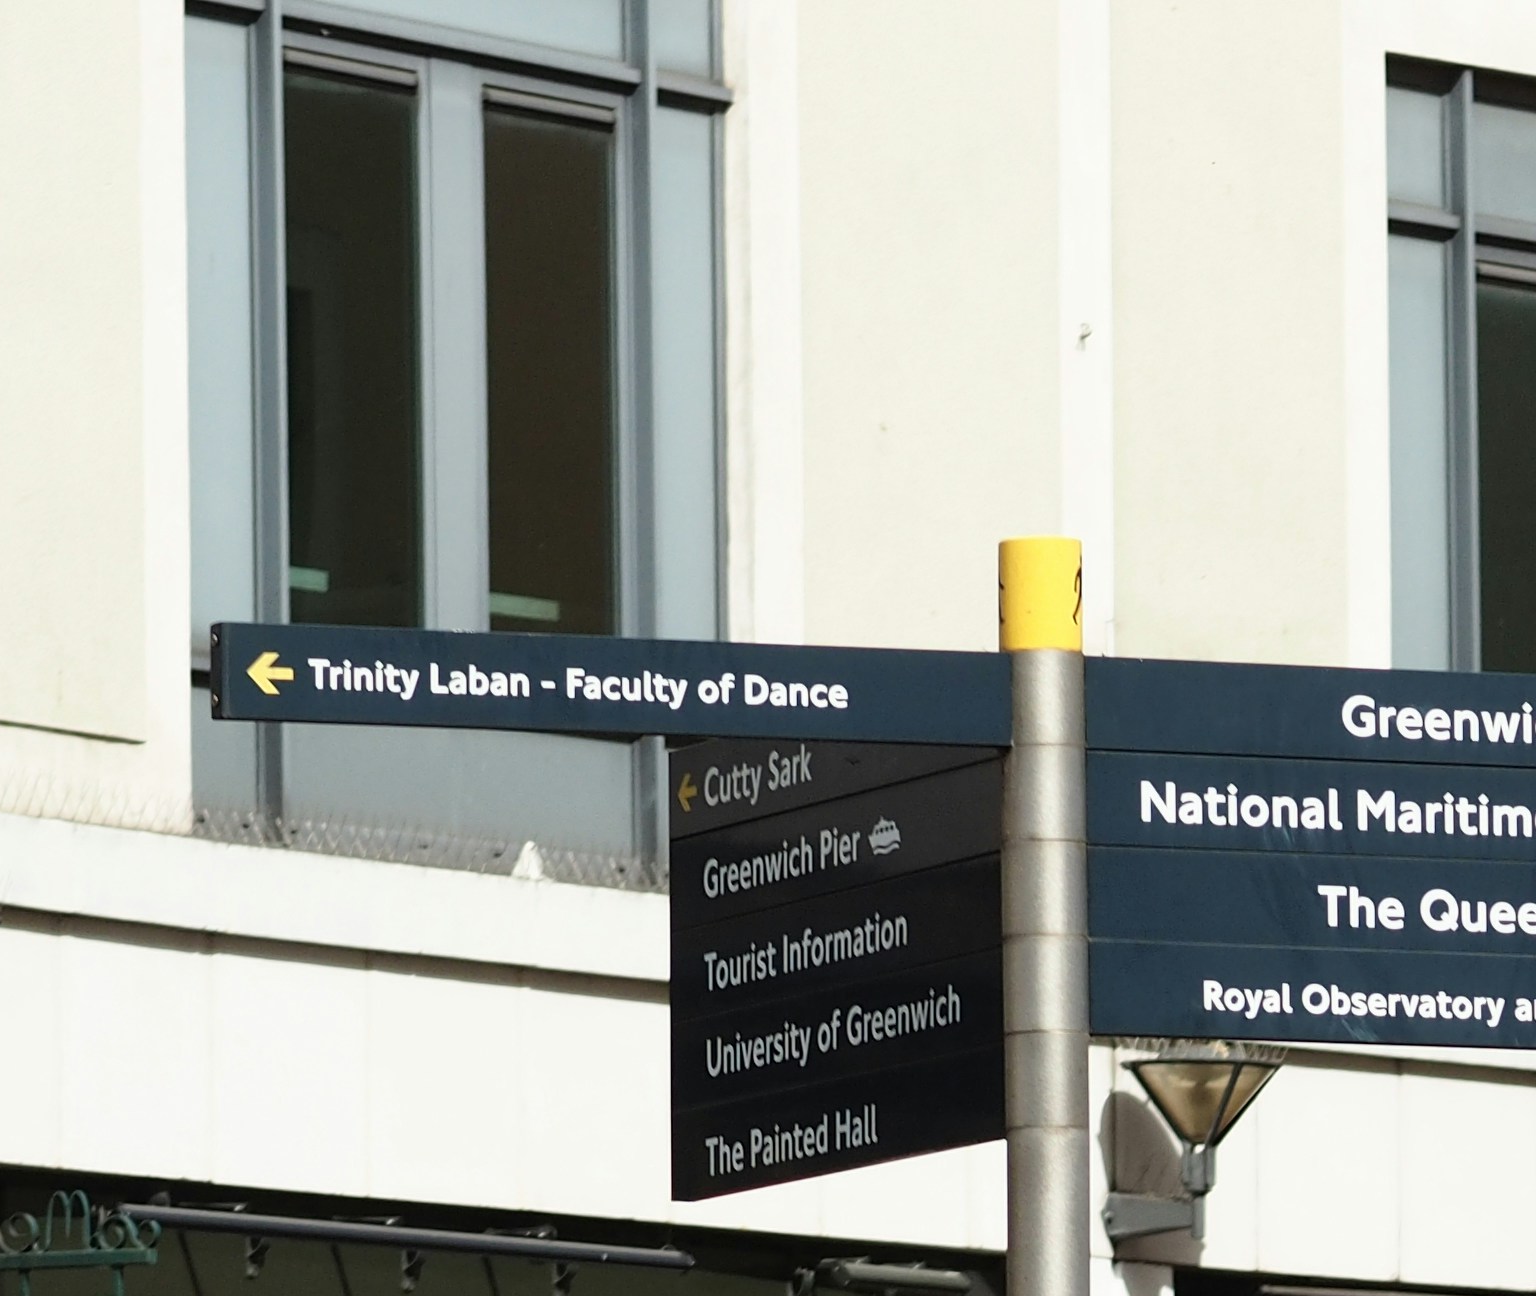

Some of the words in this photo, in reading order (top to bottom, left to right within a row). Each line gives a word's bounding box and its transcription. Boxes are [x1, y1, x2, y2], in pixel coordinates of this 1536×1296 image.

[307, 657, 420, 701] Trinity
[429, 662, 530, 698] Laban
[566, 667, 688, 710] Faculty
[697, 672, 736, 705] of
[744, 673, 849, 709] Dance
[704, 762, 762, 807] Cutty
[767, 743, 812, 791] Sark
[1140, 780, 1343, 831] National
[703, 838, 813, 898] Greenwich
[820, 827, 861, 870] Pier
[1317, 884, 1405, 930] The
[703, 941, 777, 991] Tourist
[783, 912, 908, 974] Information
[706, 1021, 811, 1077] University
[817, 1008, 841, 1053] of
[846, 984, 961, 1046] Greenwich
[1203, 979, 1294, 1020] Royal
[1301, 983, 1506, 1028] Observatory
[705, 1135, 744, 1177] The
[750, 1111, 829, 1171] Painted
[835, 1104, 878, 1146] Hall
